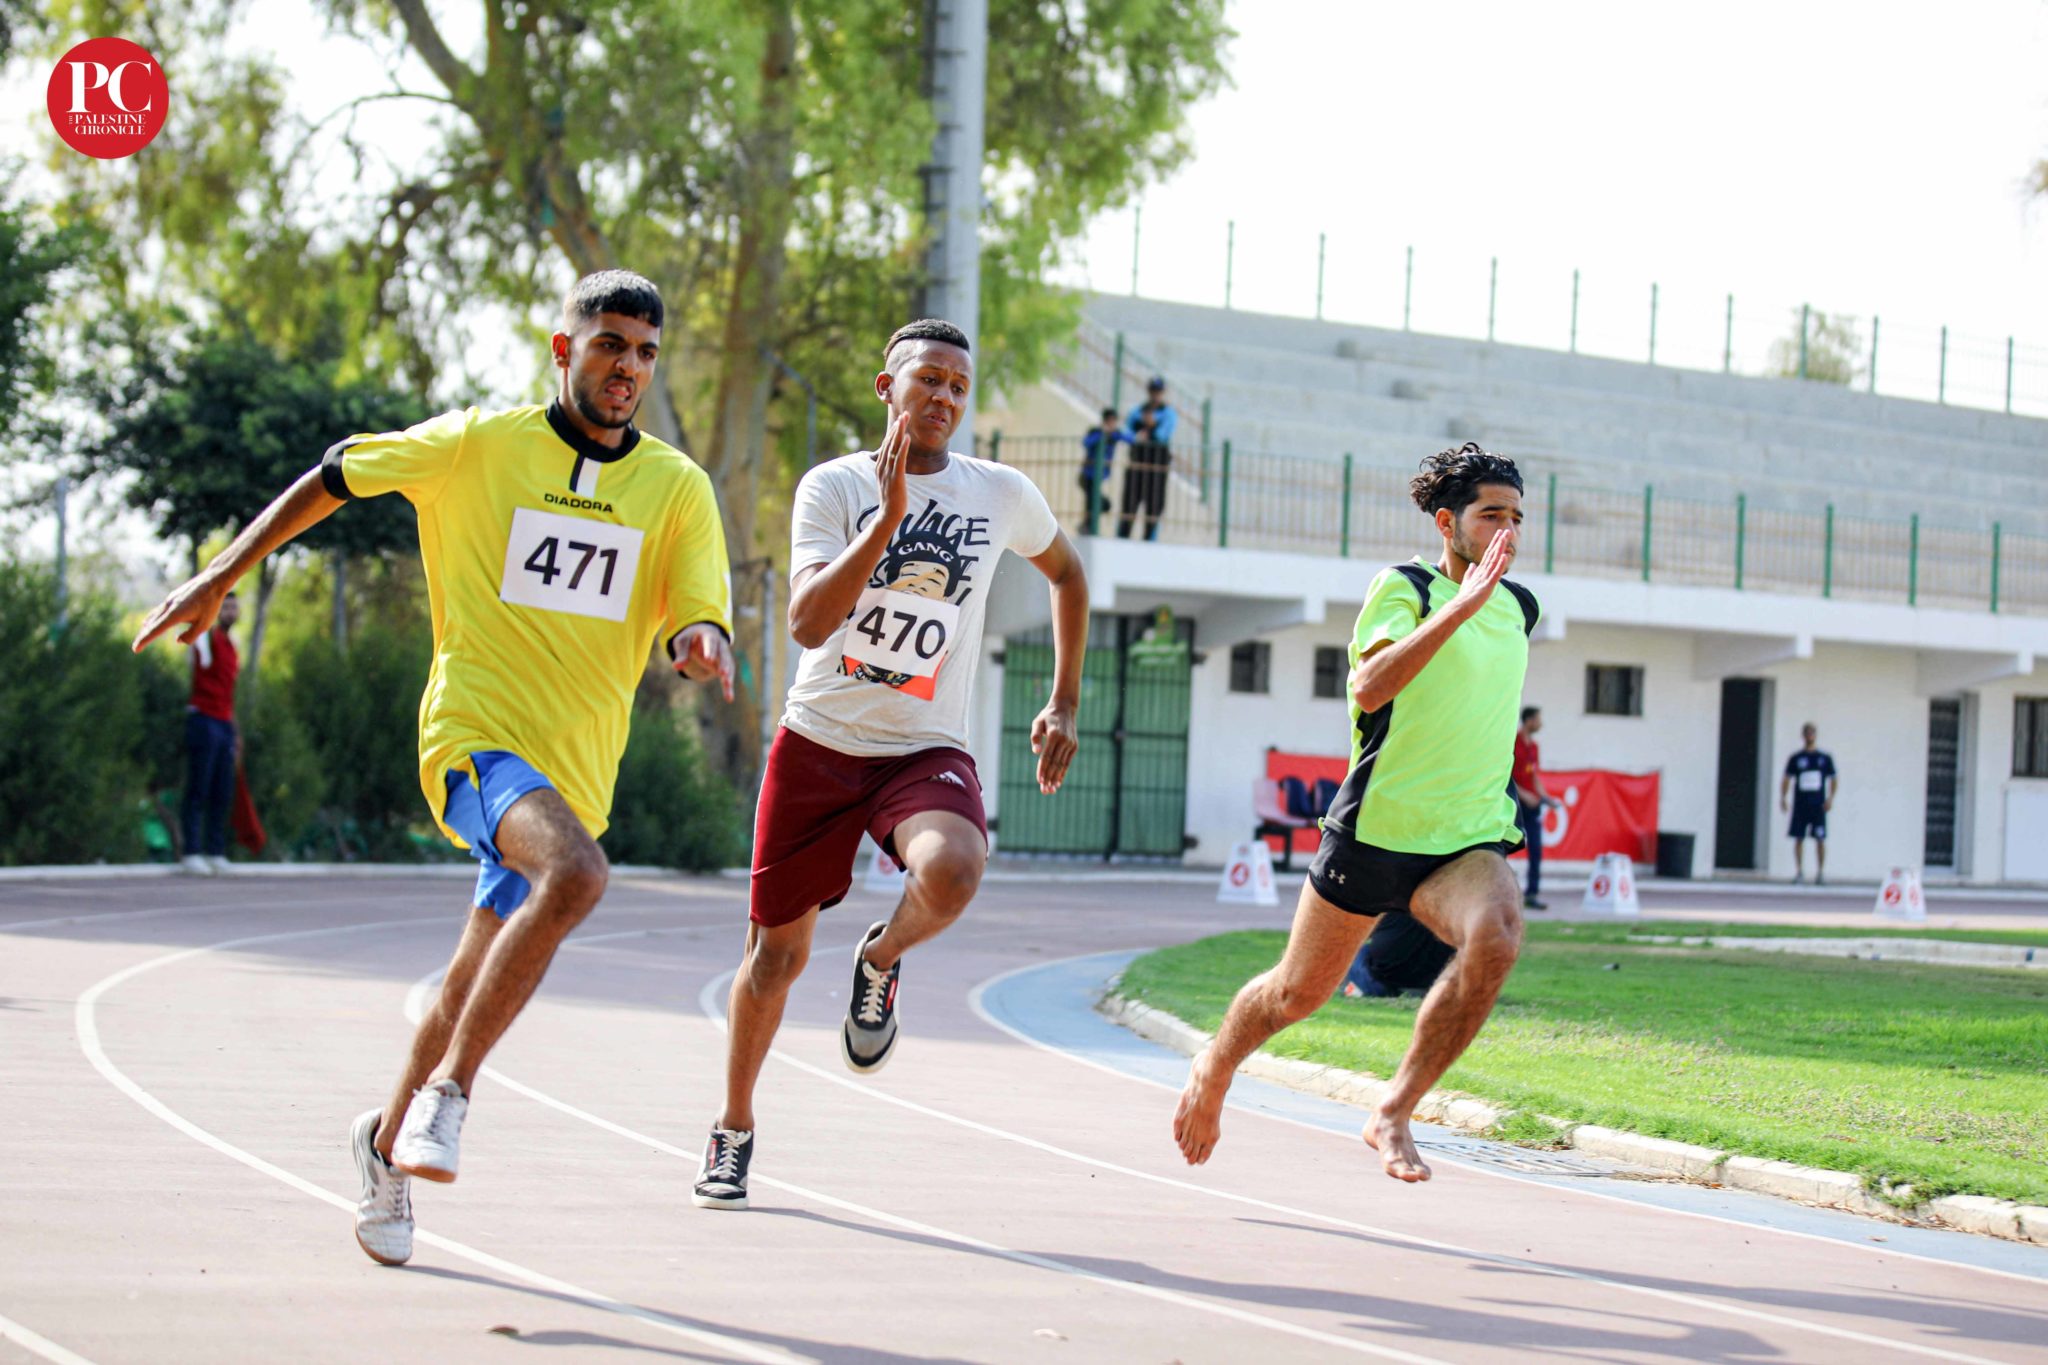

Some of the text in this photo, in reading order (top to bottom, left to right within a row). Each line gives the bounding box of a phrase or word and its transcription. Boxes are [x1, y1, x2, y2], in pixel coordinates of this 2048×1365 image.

[544, 493, 613, 513] DIADORA
[856, 498, 990, 552] VAGE
[524, 536, 619, 596] 471
[898, 541, 954, 562] GANG
[856, 605, 946, 660] 470
